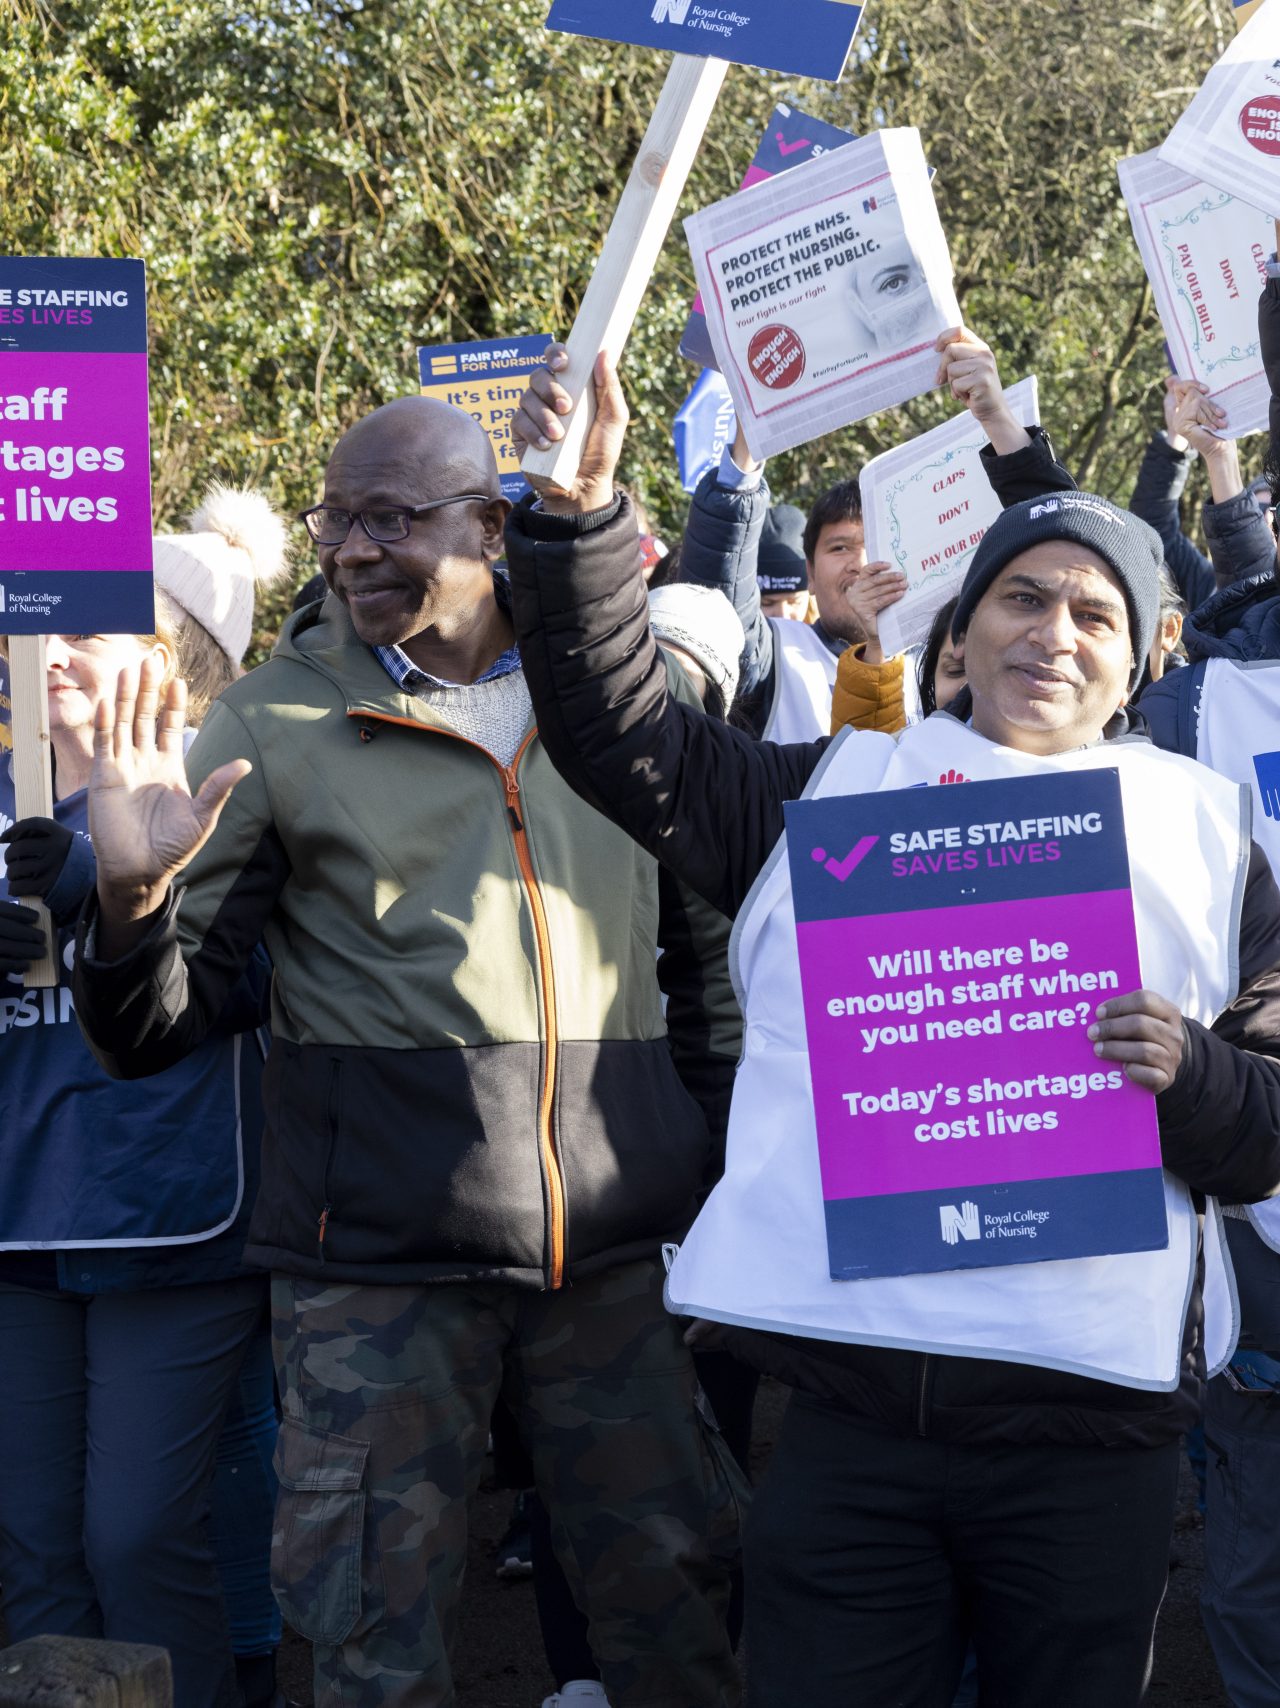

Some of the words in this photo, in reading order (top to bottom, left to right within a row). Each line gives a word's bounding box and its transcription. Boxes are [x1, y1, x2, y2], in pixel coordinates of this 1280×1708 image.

[687, 18, 699, 28] of
[699, 20, 733, 37] Nursing
[692, 5, 718, 19] Royal
[717, 10, 750, 27] College
[721, 237, 782, 275] PROTECT
[784, 226, 812, 249] THE
[815, 211, 851, 235] NHS.
[726, 256, 786, 293] PROTECT
[789, 226, 860, 266] NURSING.
[730, 274, 792, 312] PROTECT
[794, 262, 822, 284] THE
[825, 239, 881, 272] PUBLIC.
[1219, 258, 1240, 300] DON'T
[17, 289, 128, 307] STAFFING
[735, 315, 756, 329] Your
[756, 303, 779, 320] fight
[779, 300, 788, 311] is
[788, 295, 804, 307] our
[804, 285, 827, 302] fight
[1177, 243, 1194, 269] PAY
[1186, 272, 1203, 302] OUR
[1196, 304, 1216, 343] BILLS
[32, 309, 94, 325] LIVES
[460, 352, 491, 363] FAIR
[493, 348, 519, 360] PAY
[752, 329, 788, 370] ENOUGH
[764, 346, 801, 386] ENOUGH
[770, 352, 782, 366] IS
[462, 361, 488, 373] FOR
[0, 387, 68, 421] aff
[447, 390, 481, 405] It's
[487, 386, 524, 402] tim
[490, 407, 520, 424] pa
[0, 440, 125, 480] tages
[932, 468, 966, 494] CLAPS
[16, 486, 118, 522] lives
[938, 500, 970, 525] DON'T
[920, 552, 941, 571] PAY
[944, 539, 967, 559] OUR
[9, 593, 31, 605] Royal
[32, 593, 62, 605] College
[9, 604, 18, 613] of
[20, 605, 51, 616] Nursing
[889, 826, 962, 855] SAFE
[967, 812, 1103, 847] STAFFING
[891, 847, 979, 878] SAVES
[987, 841, 1062, 868] LIVES
[868, 948, 933, 980] Will
[939, 942, 1024, 971] there
[1029, 938, 1069, 963] be
[826, 983, 945, 1017] enough
[951, 973, 1025, 1005] staff
[1029, 967, 1119, 997] when
[860, 1022, 919, 1053] you
[926, 1009, 1003, 1041] need
[1009, 1002, 1092, 1033] care?
[842, 1082, 962, 1116] Today's
[967, 1069, 1124, 1104] shortages
[914, 1115, 981, 1142] cost
[987, 1108, 1059, 1136] lives
[984, 1211, 1011, 1228] Royal
[1013, 1210, 1050, 1224] College
[985, 1227, 997, 1239] of
[998, 1225, 1037, 1239] Nursing
